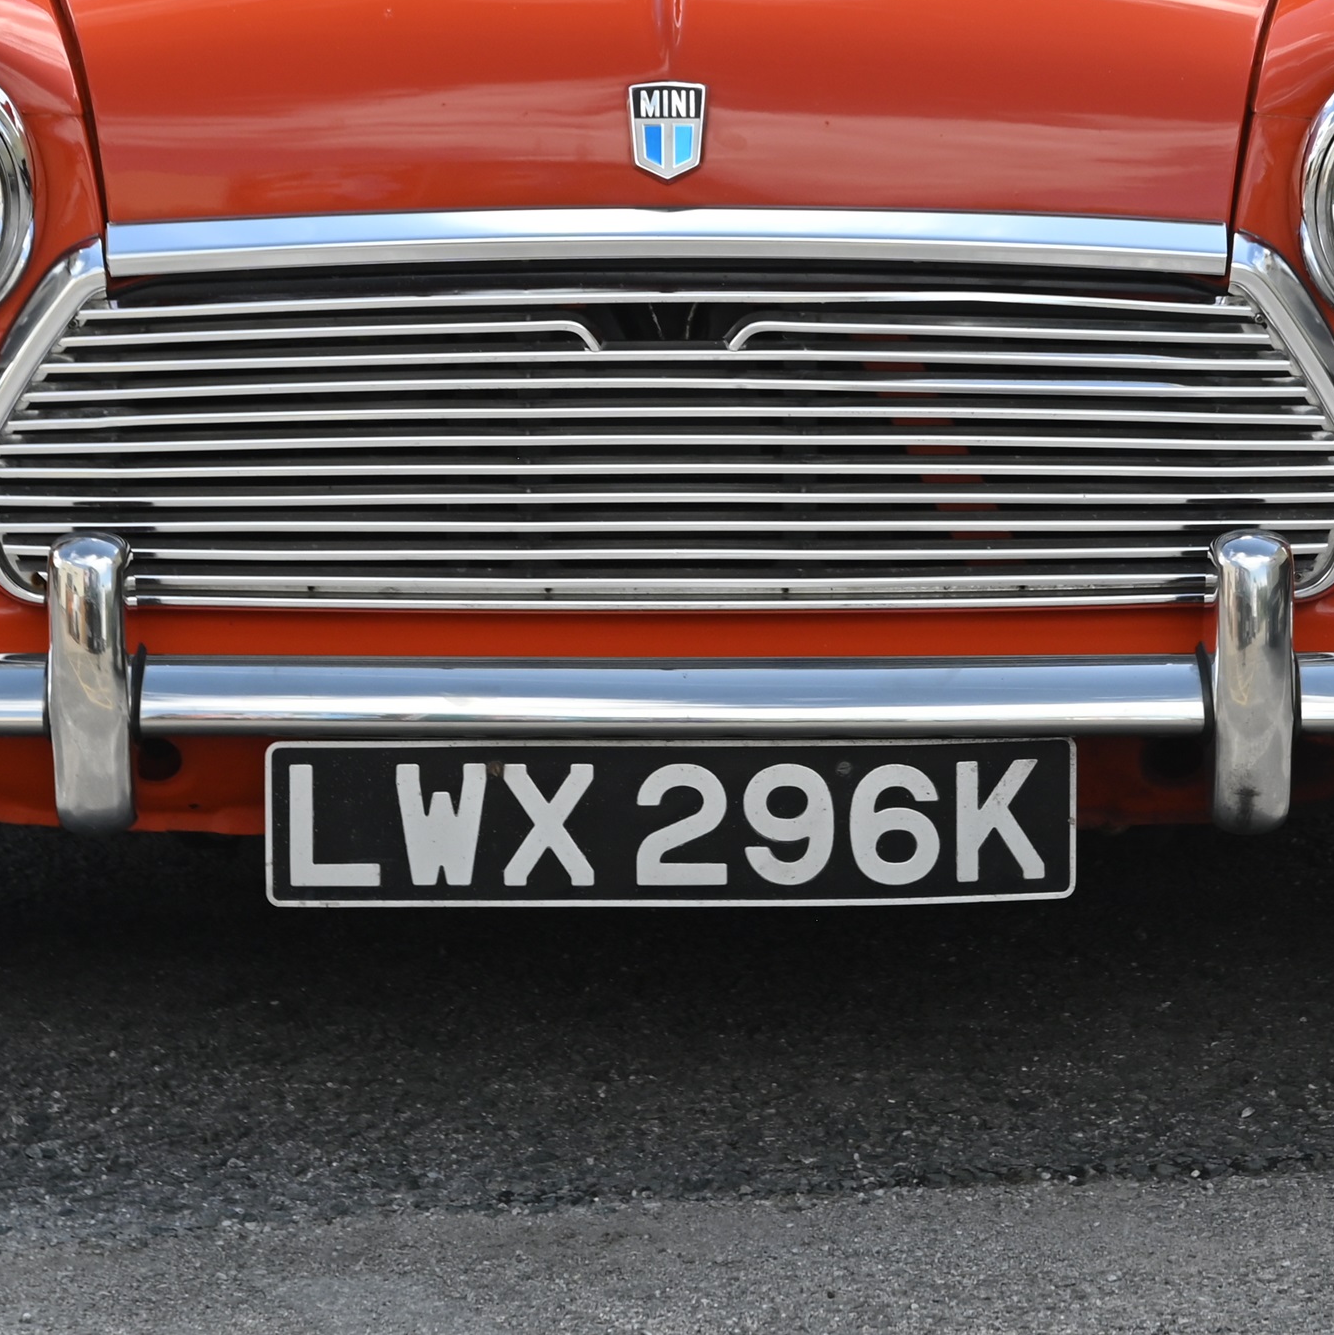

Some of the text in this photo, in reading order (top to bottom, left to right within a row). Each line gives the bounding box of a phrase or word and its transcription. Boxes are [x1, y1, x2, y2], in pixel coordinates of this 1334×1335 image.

[640, 90, 695, 117] MINI
[289, 759, 1046, 886] LWX 296K
